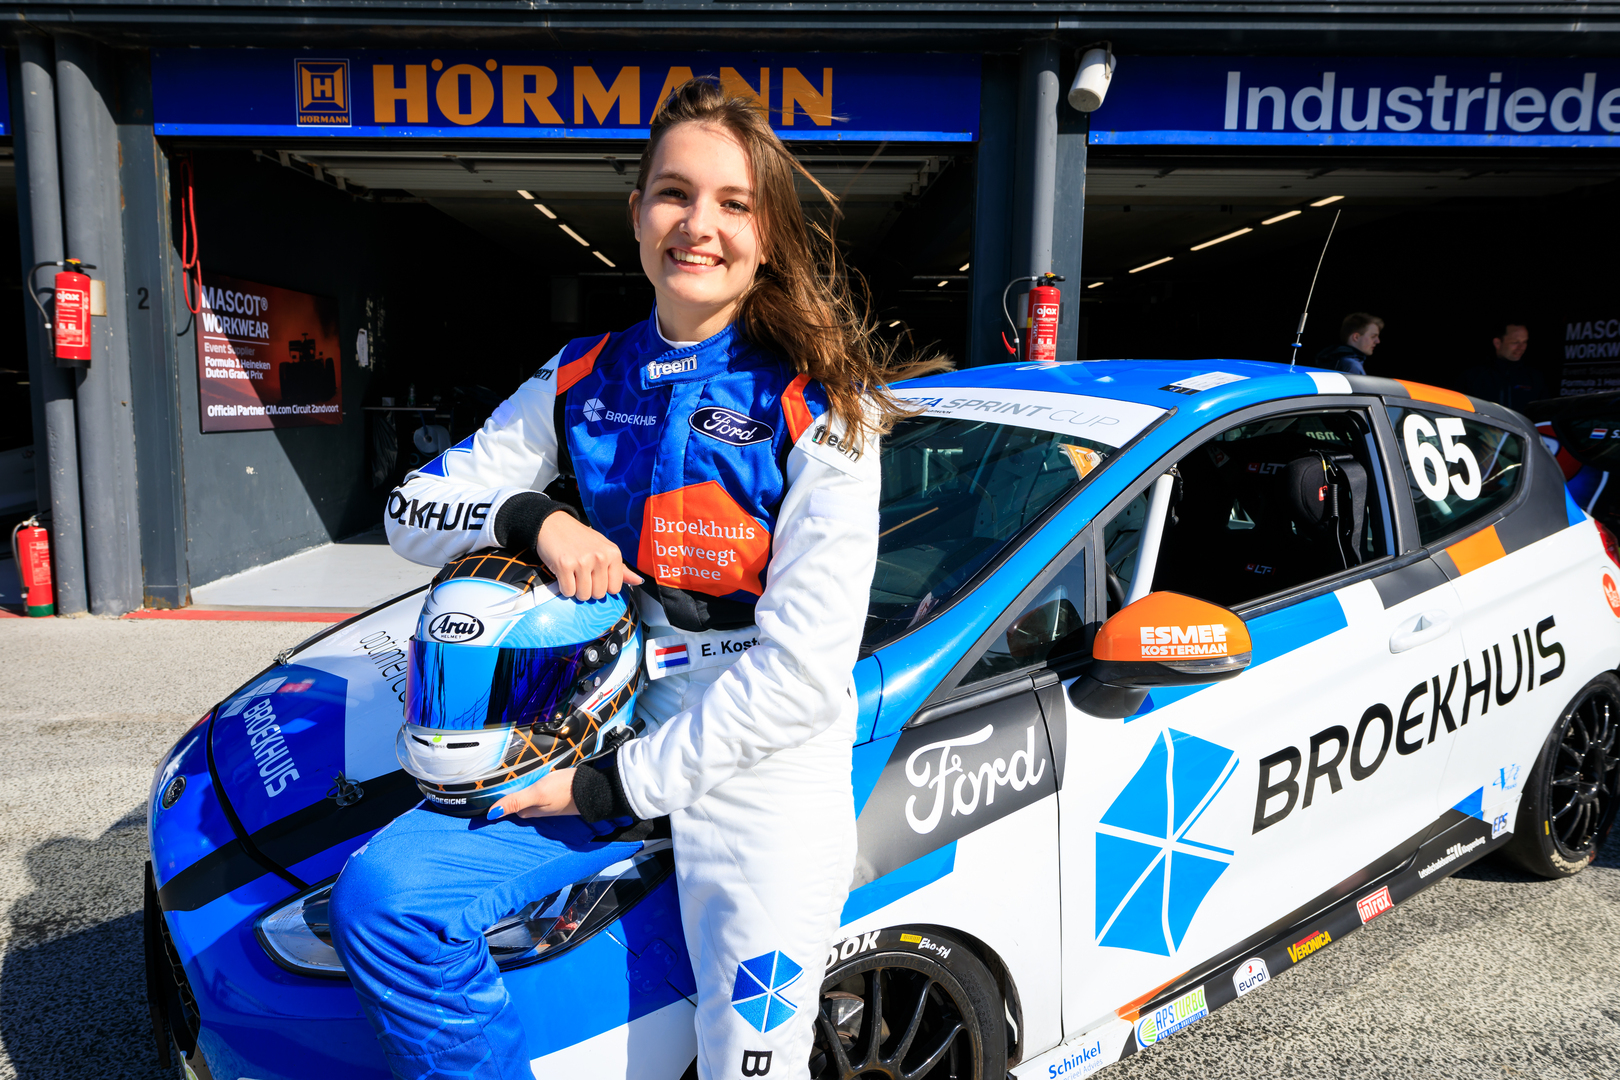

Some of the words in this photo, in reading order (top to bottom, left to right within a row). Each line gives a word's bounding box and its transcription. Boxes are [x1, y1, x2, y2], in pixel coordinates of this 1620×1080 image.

[1223, 71, 1620, 133] Industriede
[56, 291, 80, 302] ajax
[137, 287, 150, 310] 2
[1037, 305, 1057, 317] ajax
[202, 313, 269, 339] WORKWEAR
[1565, 319, 1620, 341] MASC
[204, 342, 226, 354] Event
[227, 345, 255, 356] Supplier
[205, 356, 235, 368] Formula
[241, 359, 271, 370] Heineken
[205, 368, 228, 379] Dutch
[229, 369, 249, 380] Grand
[250, 370, 264, 380] Prix
[647, 354, 697, 380] freem
[207, 405, 236, 417] Official
[237, 405, 265, 416] Partner
[292, 404, 311, 414] Circuit
[311, 404, 339, 413] Zandvoort
[605, 411, 657, 427] BROEKHUIS
[941, 398, 1053, 418] SPRINT
[1049, 409, 1120, 428] CUP
[703, 410, 754, 441] Ford
[1403, 414, 1482, 502] 65
[653, 516, 755, 540] Broekhuis
[654, 540, 737, 566] beweegt
[658, 565, 721, 581] Esmee
[431, 615, 476, 634] Arai
[1140, 624, 1227, 644] ESMEE
[701, 643, 716, 657] E.
[721, 637, 760, 654] Kost
[1141, 642, 1227, 656] KOSTERMAN
[1252, 615, 1566, 836] BROEKHUIS
[243, 698, 300, 798] BROEKHUIS
[905, 723, 1046, 834] Ford
[1287, 931, 1332, 963] VERONICA
[1238, 967, 1266, 992] eurol
[1048, 1040, 1101, 1080] Schinkel
[1083, 1059, 1103, 1074] Advies
